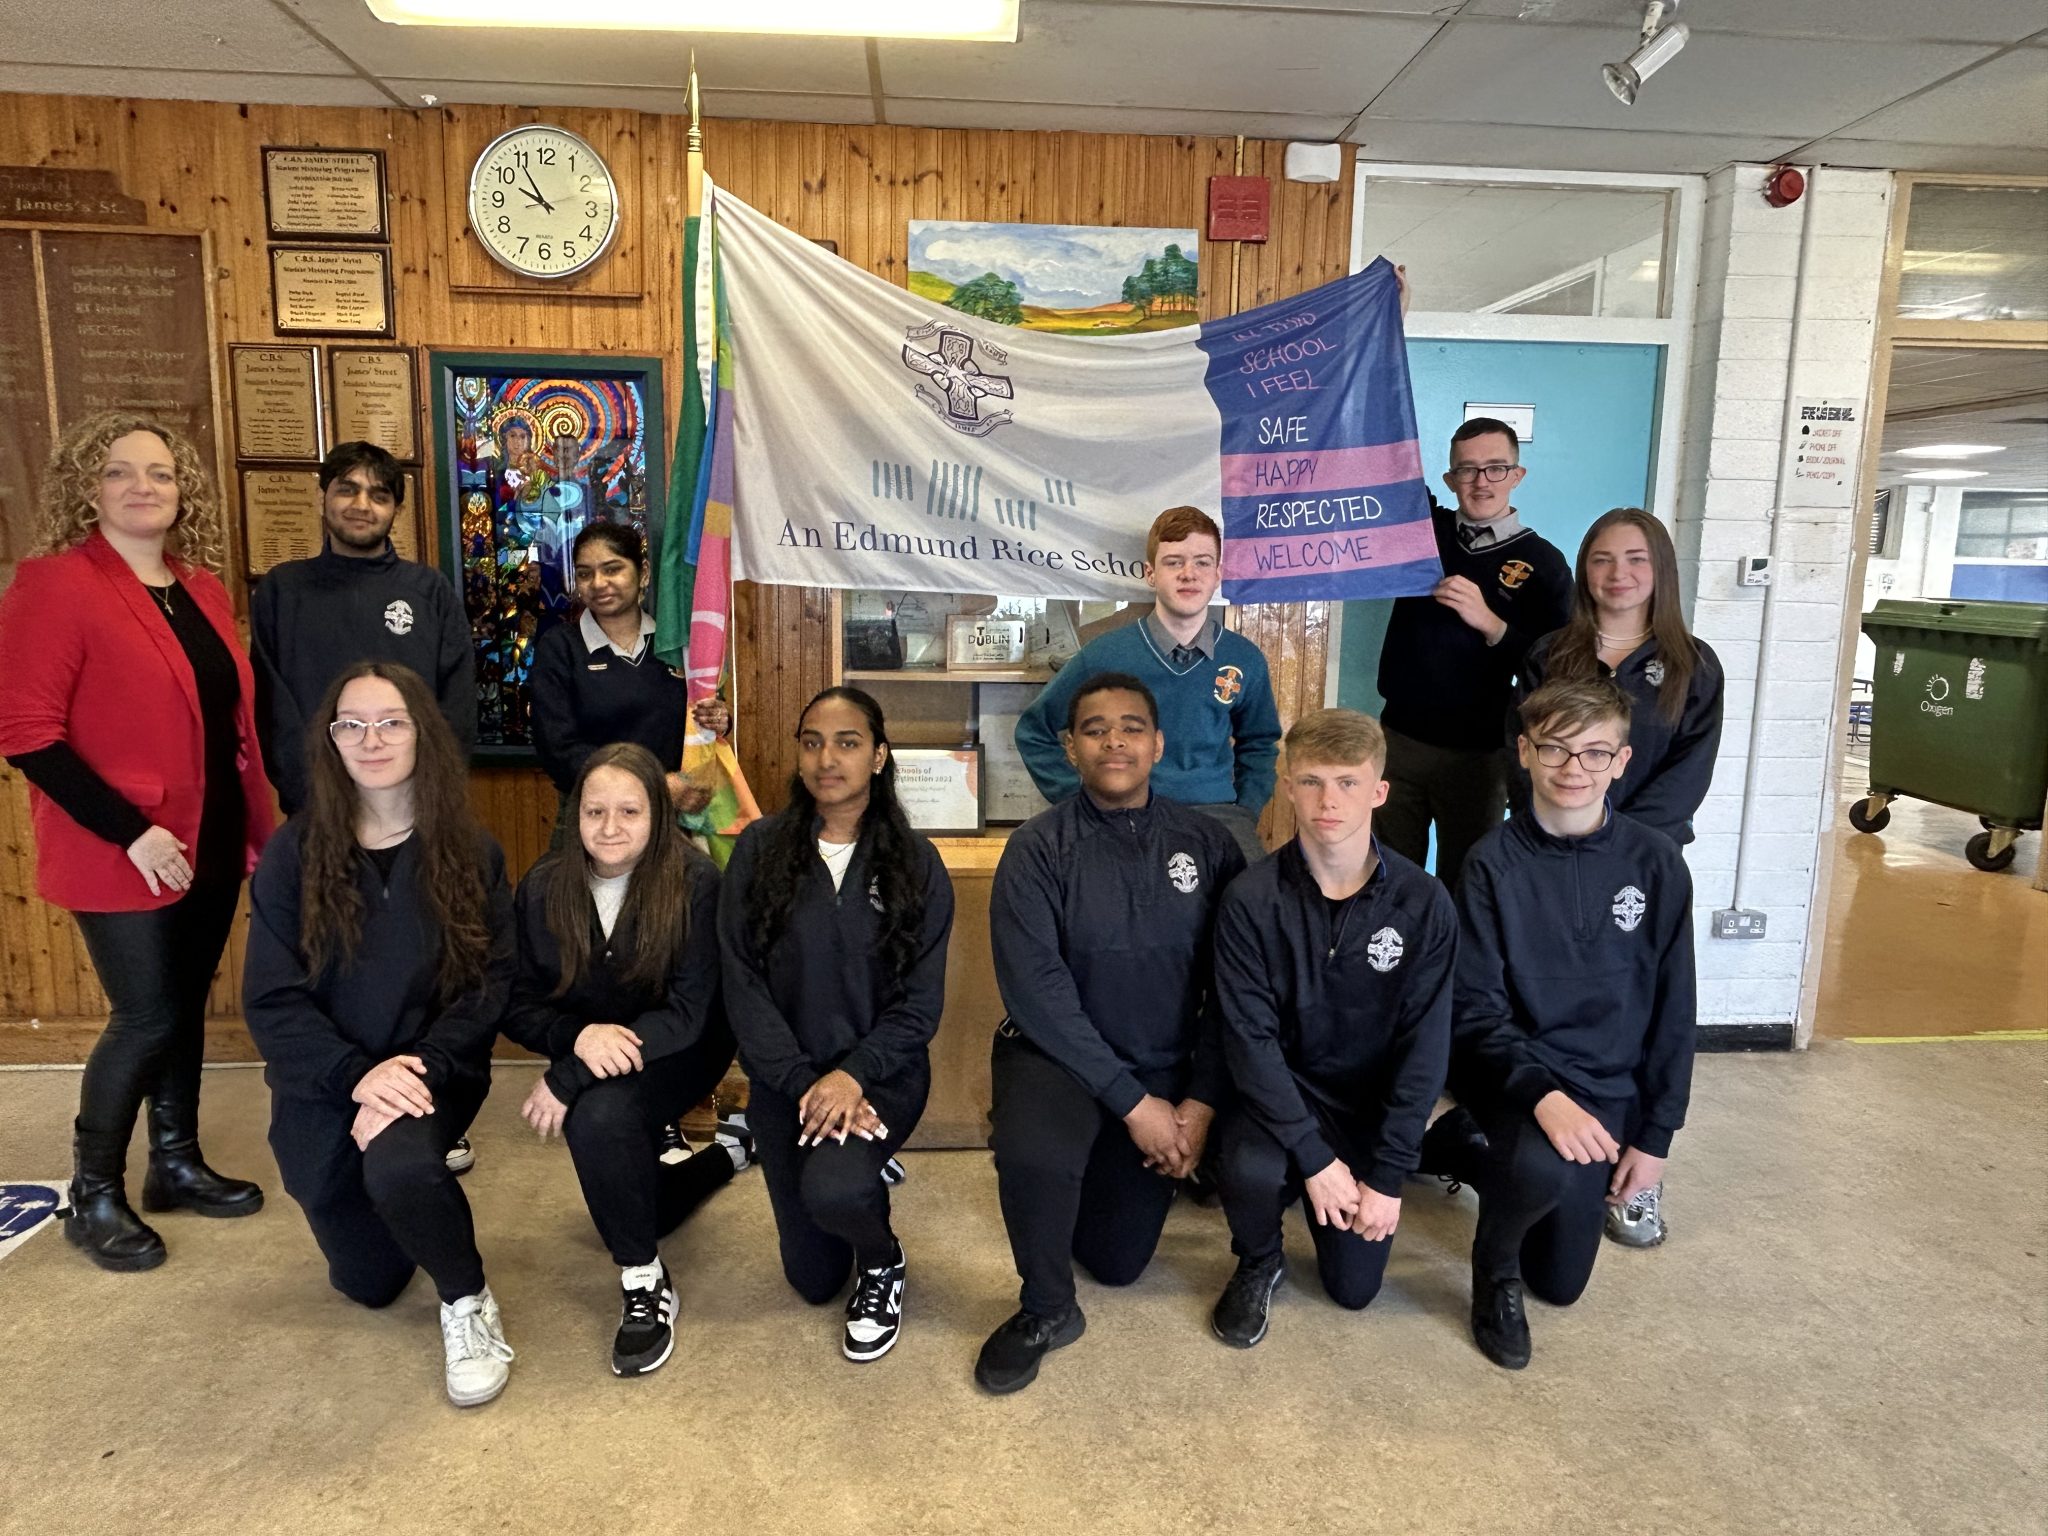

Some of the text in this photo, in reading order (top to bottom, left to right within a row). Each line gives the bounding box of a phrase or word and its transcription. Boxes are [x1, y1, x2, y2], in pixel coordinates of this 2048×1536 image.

[513, 150, 529, 169] 11
[536, 147, 556, 166] 12
[568, 154, 575, 173] 1
[495, 166, 516, 185] 10
[579, 174, 592, 193] 2
[491, 190, 505, 209] 9
[585, 200, 598, 219] 3
[497, 215, 511, 234] 8
[578, 224, 593, 242] 4
[516, 236, 530, 254] 7
[538, 242, 551, 261] 6
[563, 240, 576, 259] 5
[1239, 337, 1338, 375] SCHOOL
[1246, 368, 1320, 399] I FEEL
[1258, 416, 1310, 445] SAFE
[1255, 457, 1319, 488] HAPPY
[1256, 495, 1383, 530] RESPECTED
[776, 517, 824, 549] An
[832, 520, 980, 561] Edmund
[988, 538, 1064, 571] Rice
[1253, 535, 1373, 571] WELCOME
[968, 633, 1010, 646] DUBLIN
[1920, 700, 1954, 717] Oxigen
